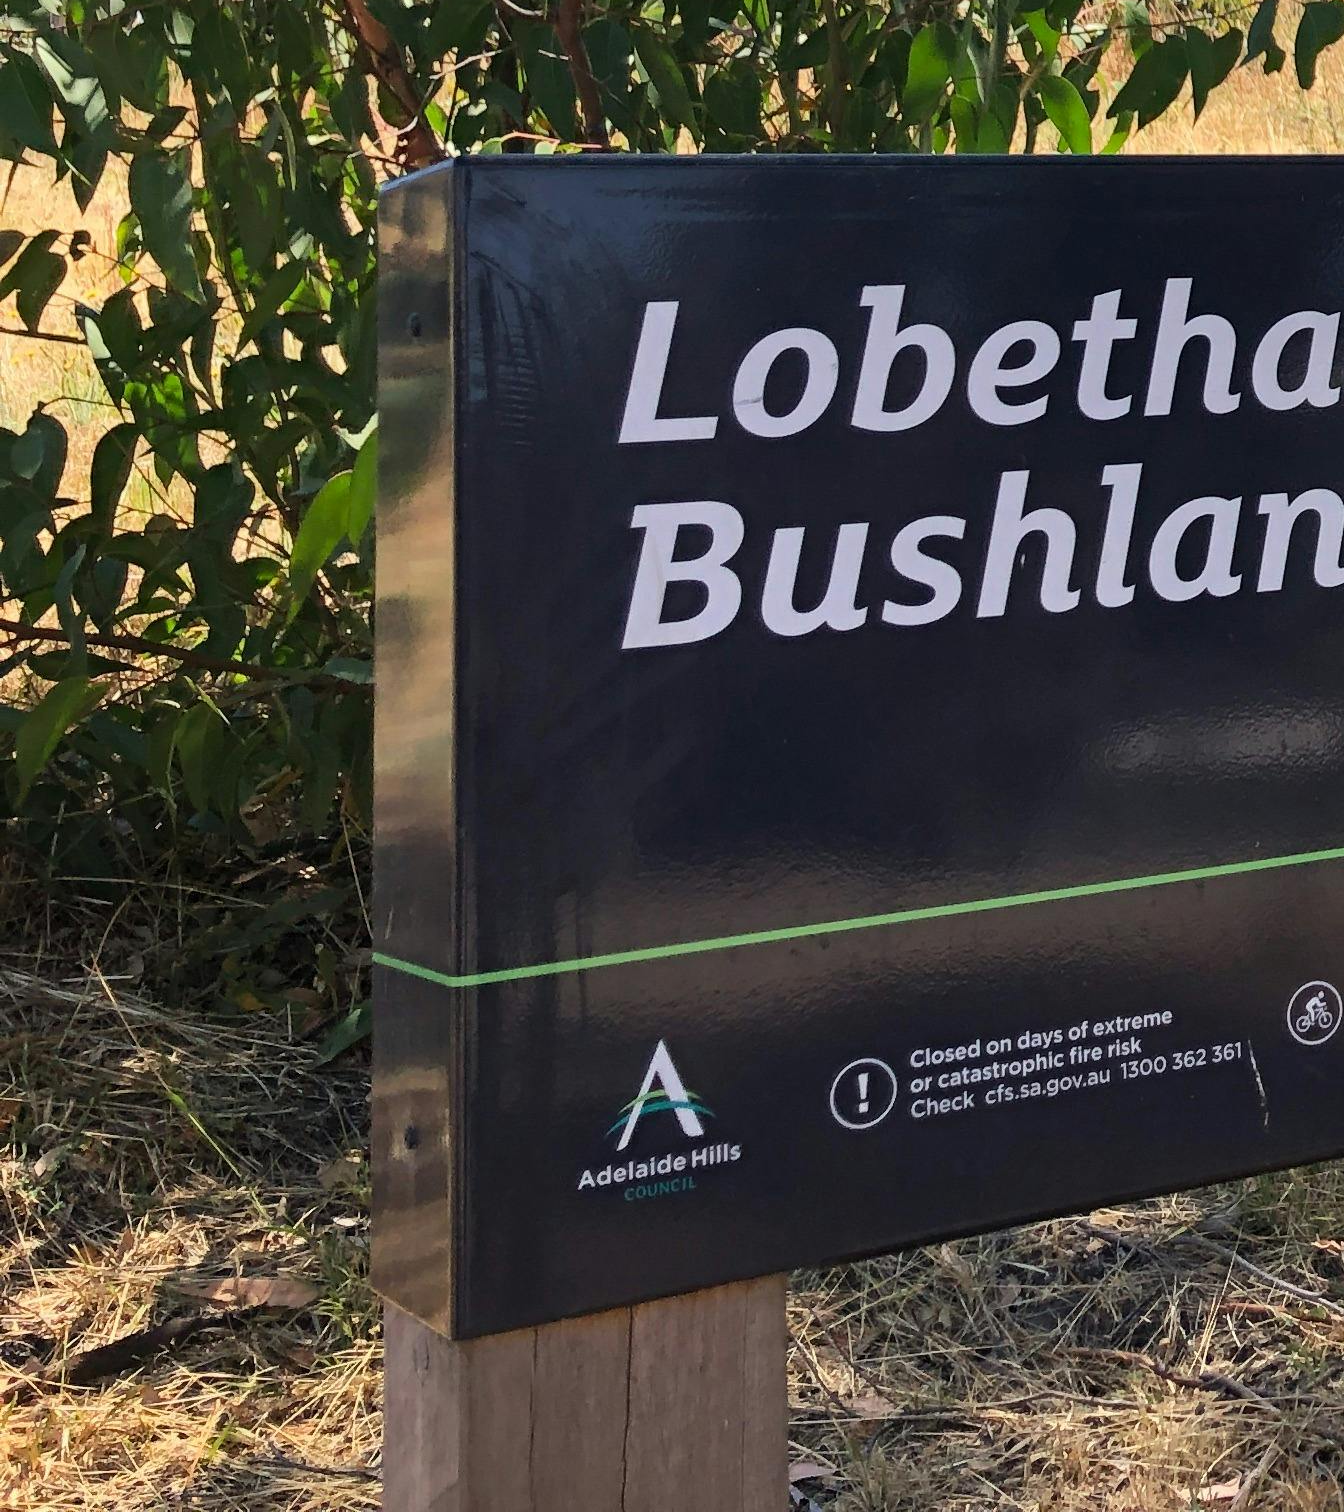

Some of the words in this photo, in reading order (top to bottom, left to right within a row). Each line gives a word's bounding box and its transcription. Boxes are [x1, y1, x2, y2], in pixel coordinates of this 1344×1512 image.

[909, 1038, 981, 1068] Closed
[986, 1037, 1012, 1056] on
[1017, 1029, 1064, 1050] days
[1068, 1020, 1089, 1041] of
[1092, 1010, 1173, 1036] extreme
[910, 1076, 933, 1094] or
[937, 1050, 1065, 1089] catastrophic
[1069, 1045, 1103, 1065] fire
[1107, 1036, 1142, 1058] risk
[910, 1090, 975, 1119] Check
[984, 1068, 1111, 1105] cfs.sa.gov.au
[1120, 1055, 1167, 1080] 1300
[1172, 1048, 1207, 1071] 362
[1211, 1041, 1242, 1064] 361
[577, 1153, 687, 1191] Adelaide
[691, 1143, 742, 1169] Hills
[623, 1176, 697, 1201] COUNCIL
